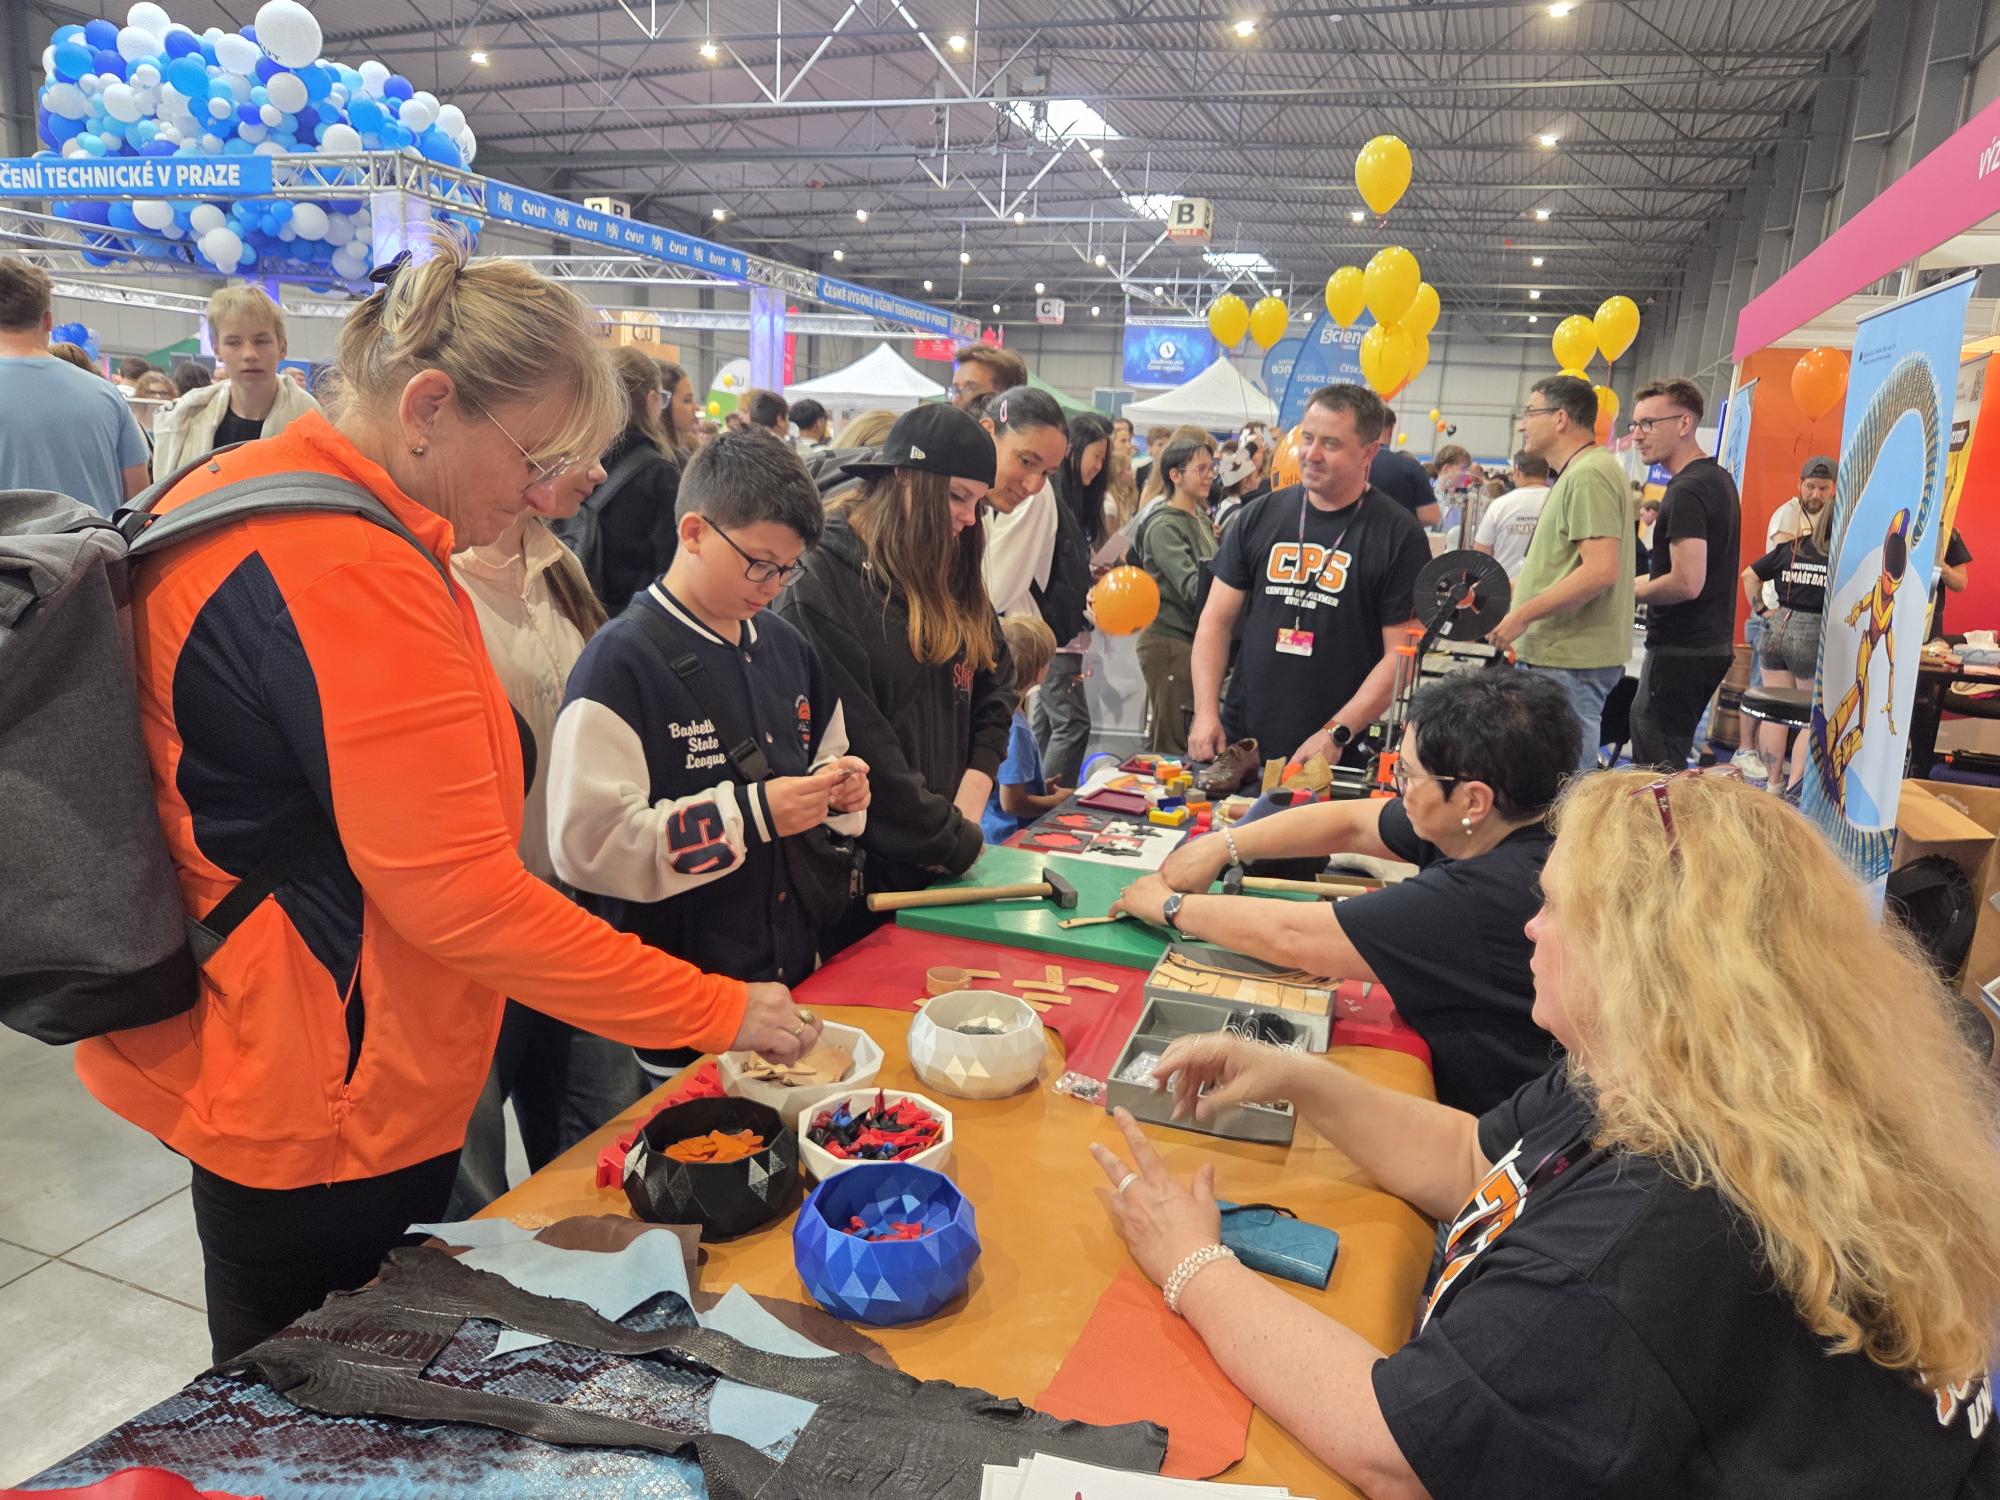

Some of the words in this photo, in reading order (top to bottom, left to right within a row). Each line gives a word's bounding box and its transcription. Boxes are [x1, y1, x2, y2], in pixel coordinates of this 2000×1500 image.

[45, 160, 154, 188] TECHNICKÉ
[157, 165, 171, 187] V
[176, 164, 241, 187] PRAZE
[1176, 203, 1195, 225] B
[521, 199, 547, 219] ČVUT
[576, 214, 599, 233] ČVUT
[624, 227, 645, 246] ČVUT
[669, 239, 688, 257] ČVUT
[823, 281, 846, 301] ČESKÉ
[1041, 302, 1052, 315] C
[1296, 374, 1326, 384] SCIENCE
[1267, 542, 1353, 593] CPS
[688, 736, 720, 753] State
[685, 752, 727, 770] League
